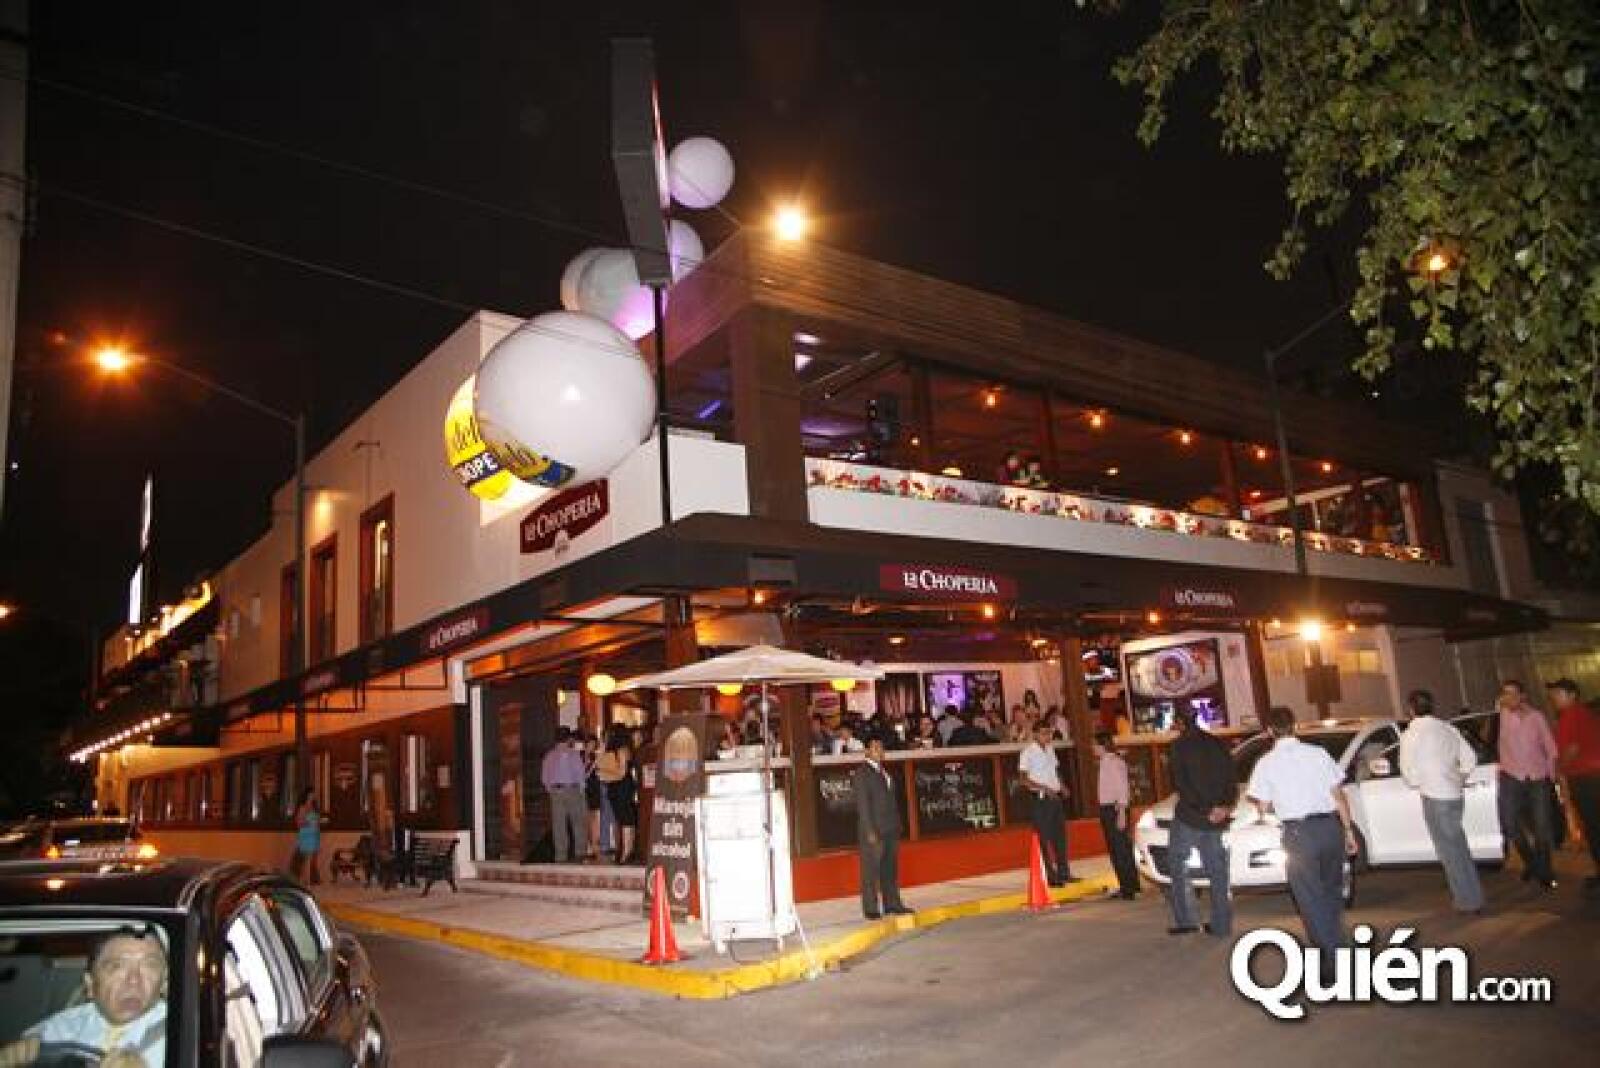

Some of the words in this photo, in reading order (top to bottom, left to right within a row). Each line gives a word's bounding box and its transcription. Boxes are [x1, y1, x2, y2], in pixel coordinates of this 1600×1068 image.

[537, 491, 600, 538] CHOPERIA
[919, 569, 998, 594] CHOPERIA
[651, 840, 691, 859] alcohol
